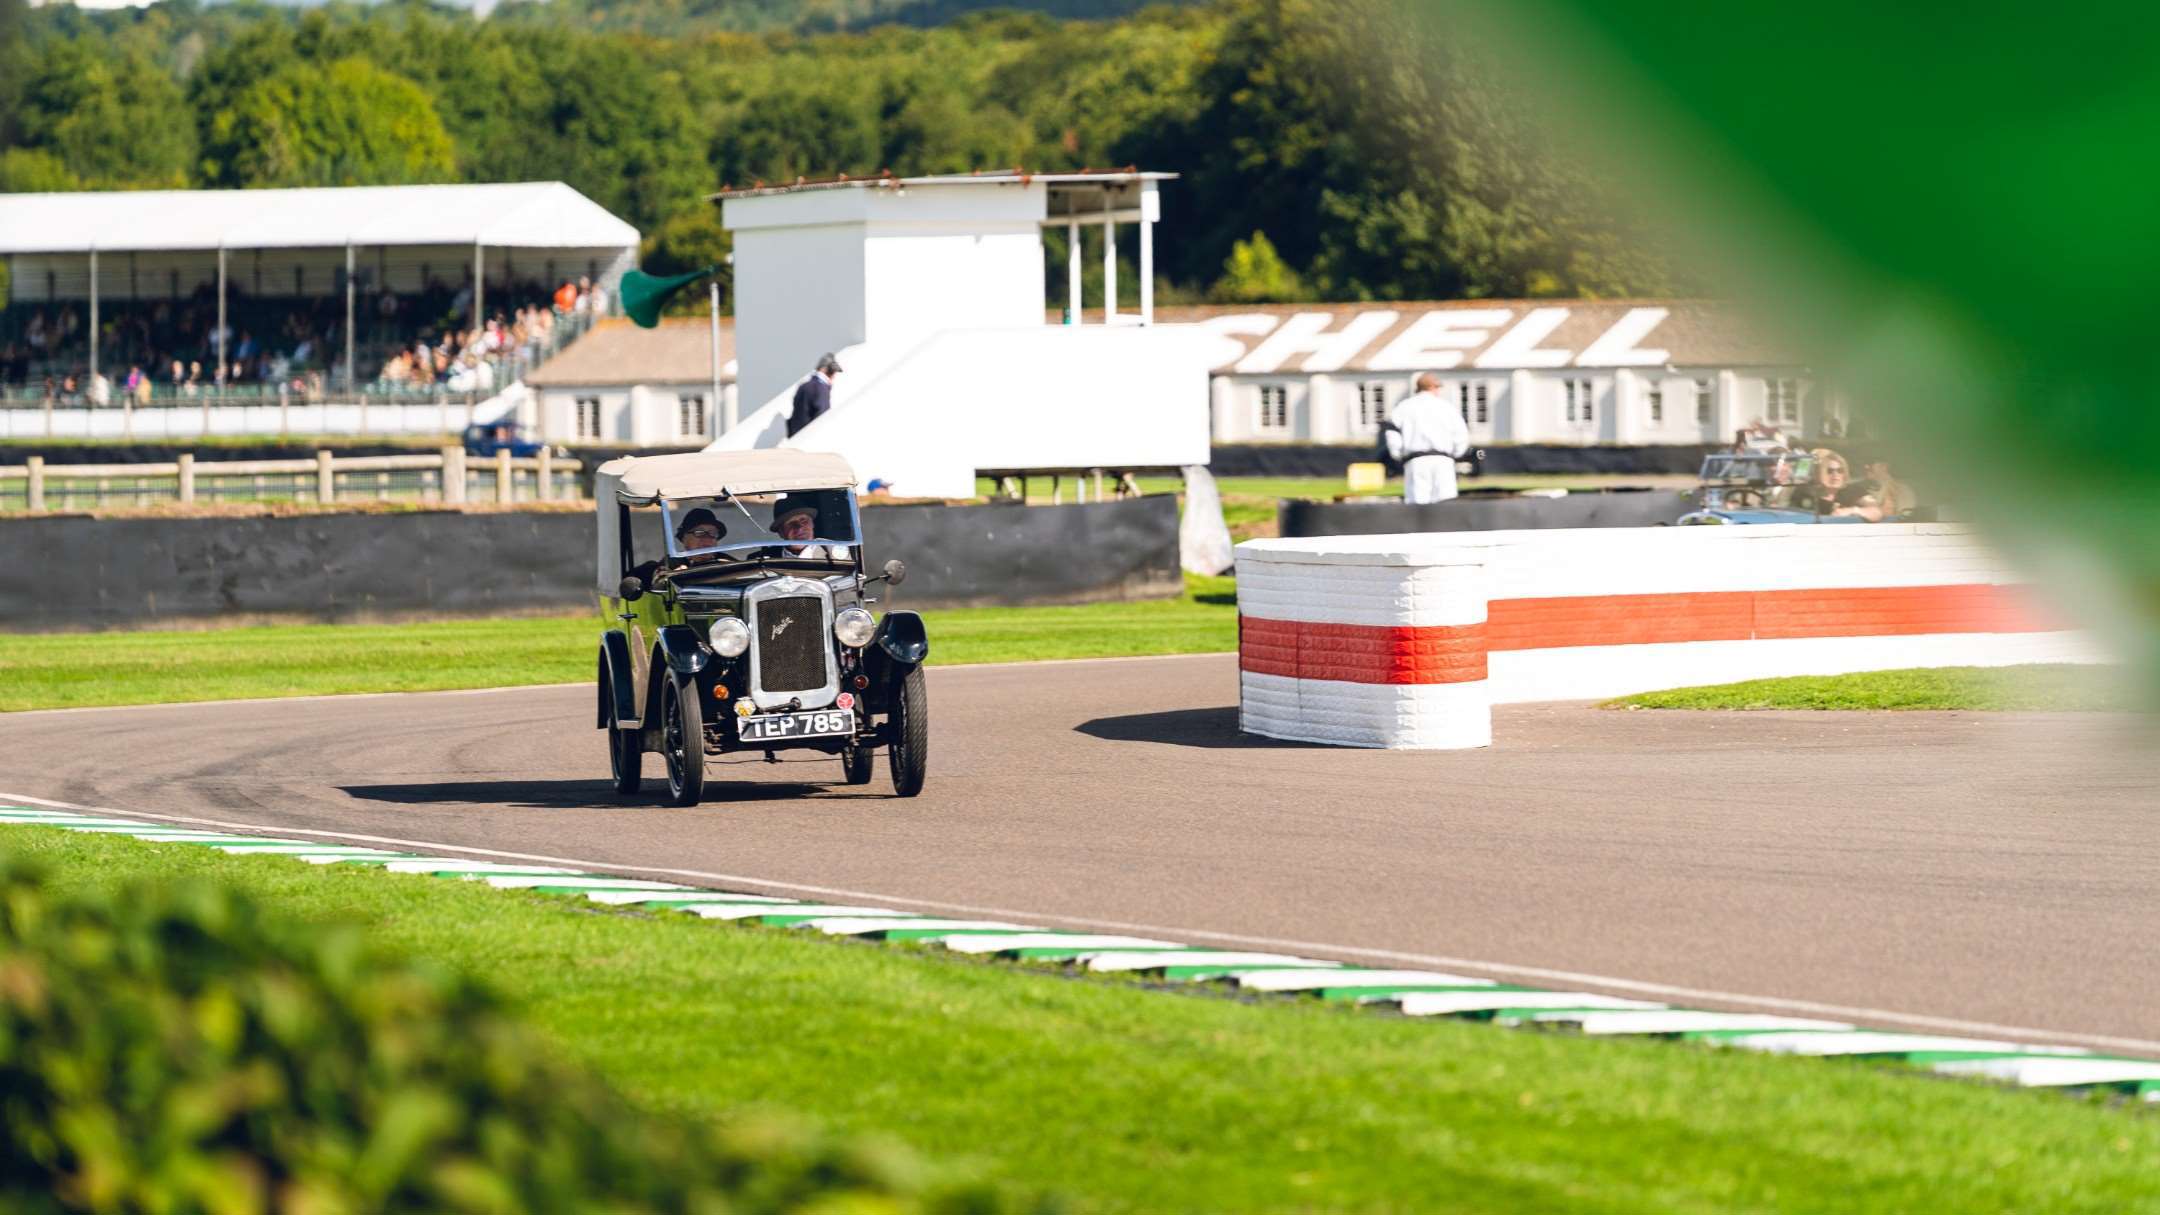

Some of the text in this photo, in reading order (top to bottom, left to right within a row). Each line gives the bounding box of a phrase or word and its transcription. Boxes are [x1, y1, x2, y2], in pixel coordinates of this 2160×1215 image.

[1199, 308, 1670, 374] SHELL
[750, 713, 844, 738] TEP 785
